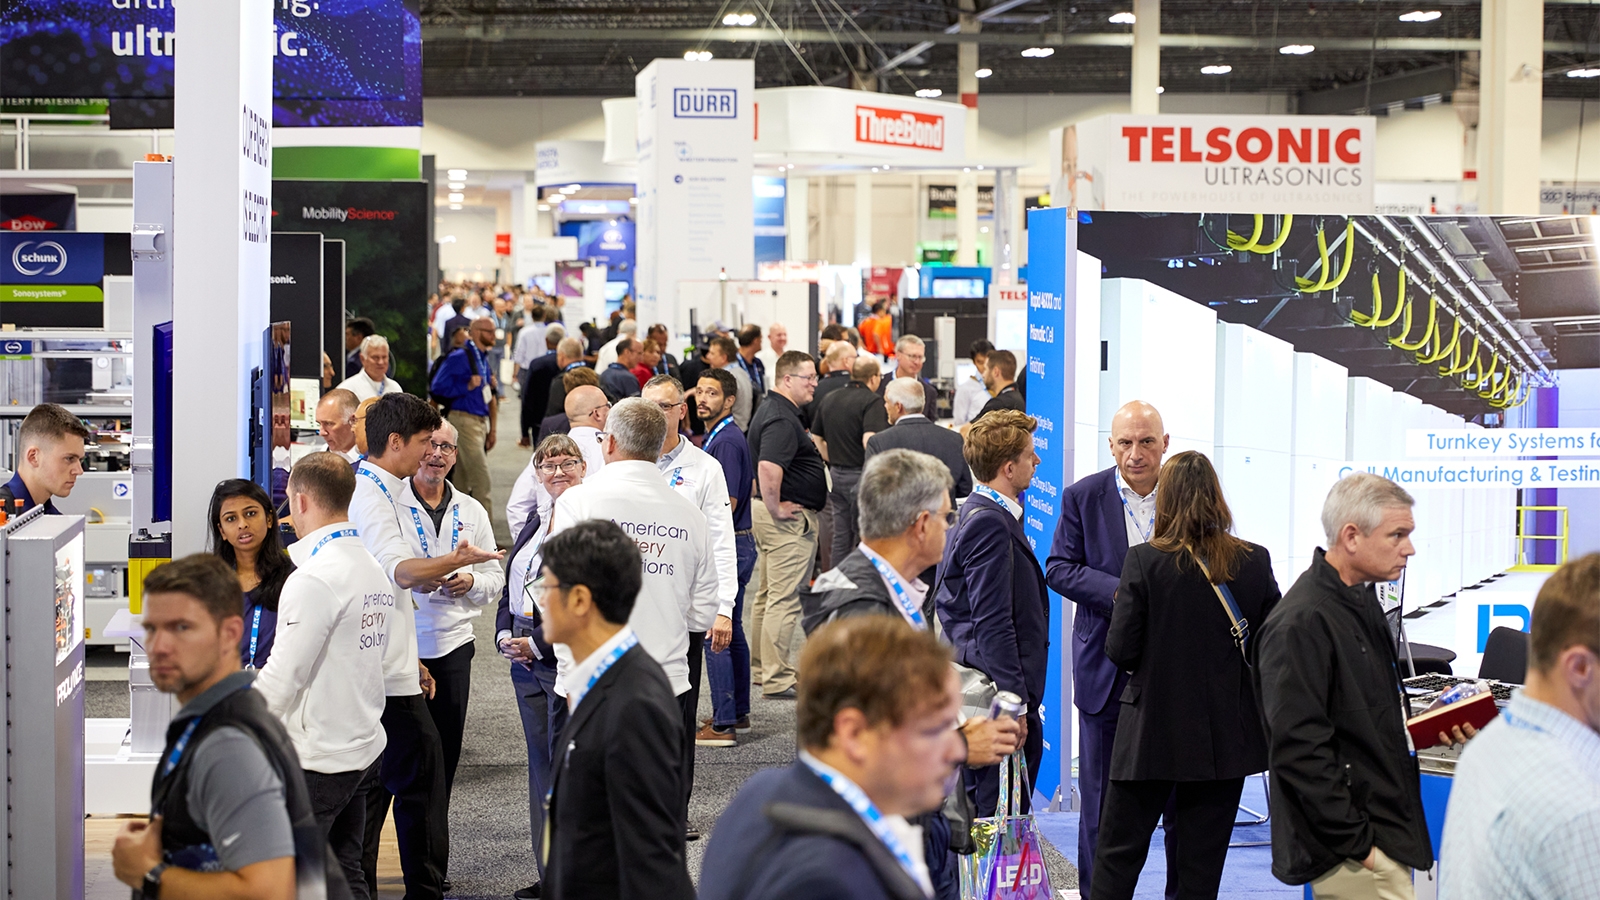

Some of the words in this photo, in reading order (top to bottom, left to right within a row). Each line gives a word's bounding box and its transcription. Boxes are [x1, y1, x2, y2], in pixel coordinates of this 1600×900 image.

[680, 87, 731, 113] DÜRR
[857, 107, 943, 150] ThreeBond
[1122, 126, 1361, 164] TELSONIC
[1205, 166, 1362, 187] ULTRASONICS
[1427, 433, 1502, 453] Turnkey
[1508, 432, 1584, 453] Systems
[1590, 431, 1600, 449] fo
[1339, 466, 1375, 482] Cll
[1383, 466, 1523, 485] Manufacturing
[1530, 466, 1542, 482] &
[1549, 464, 1600, 482] Testin
[633, 538, 666, 558] tery
